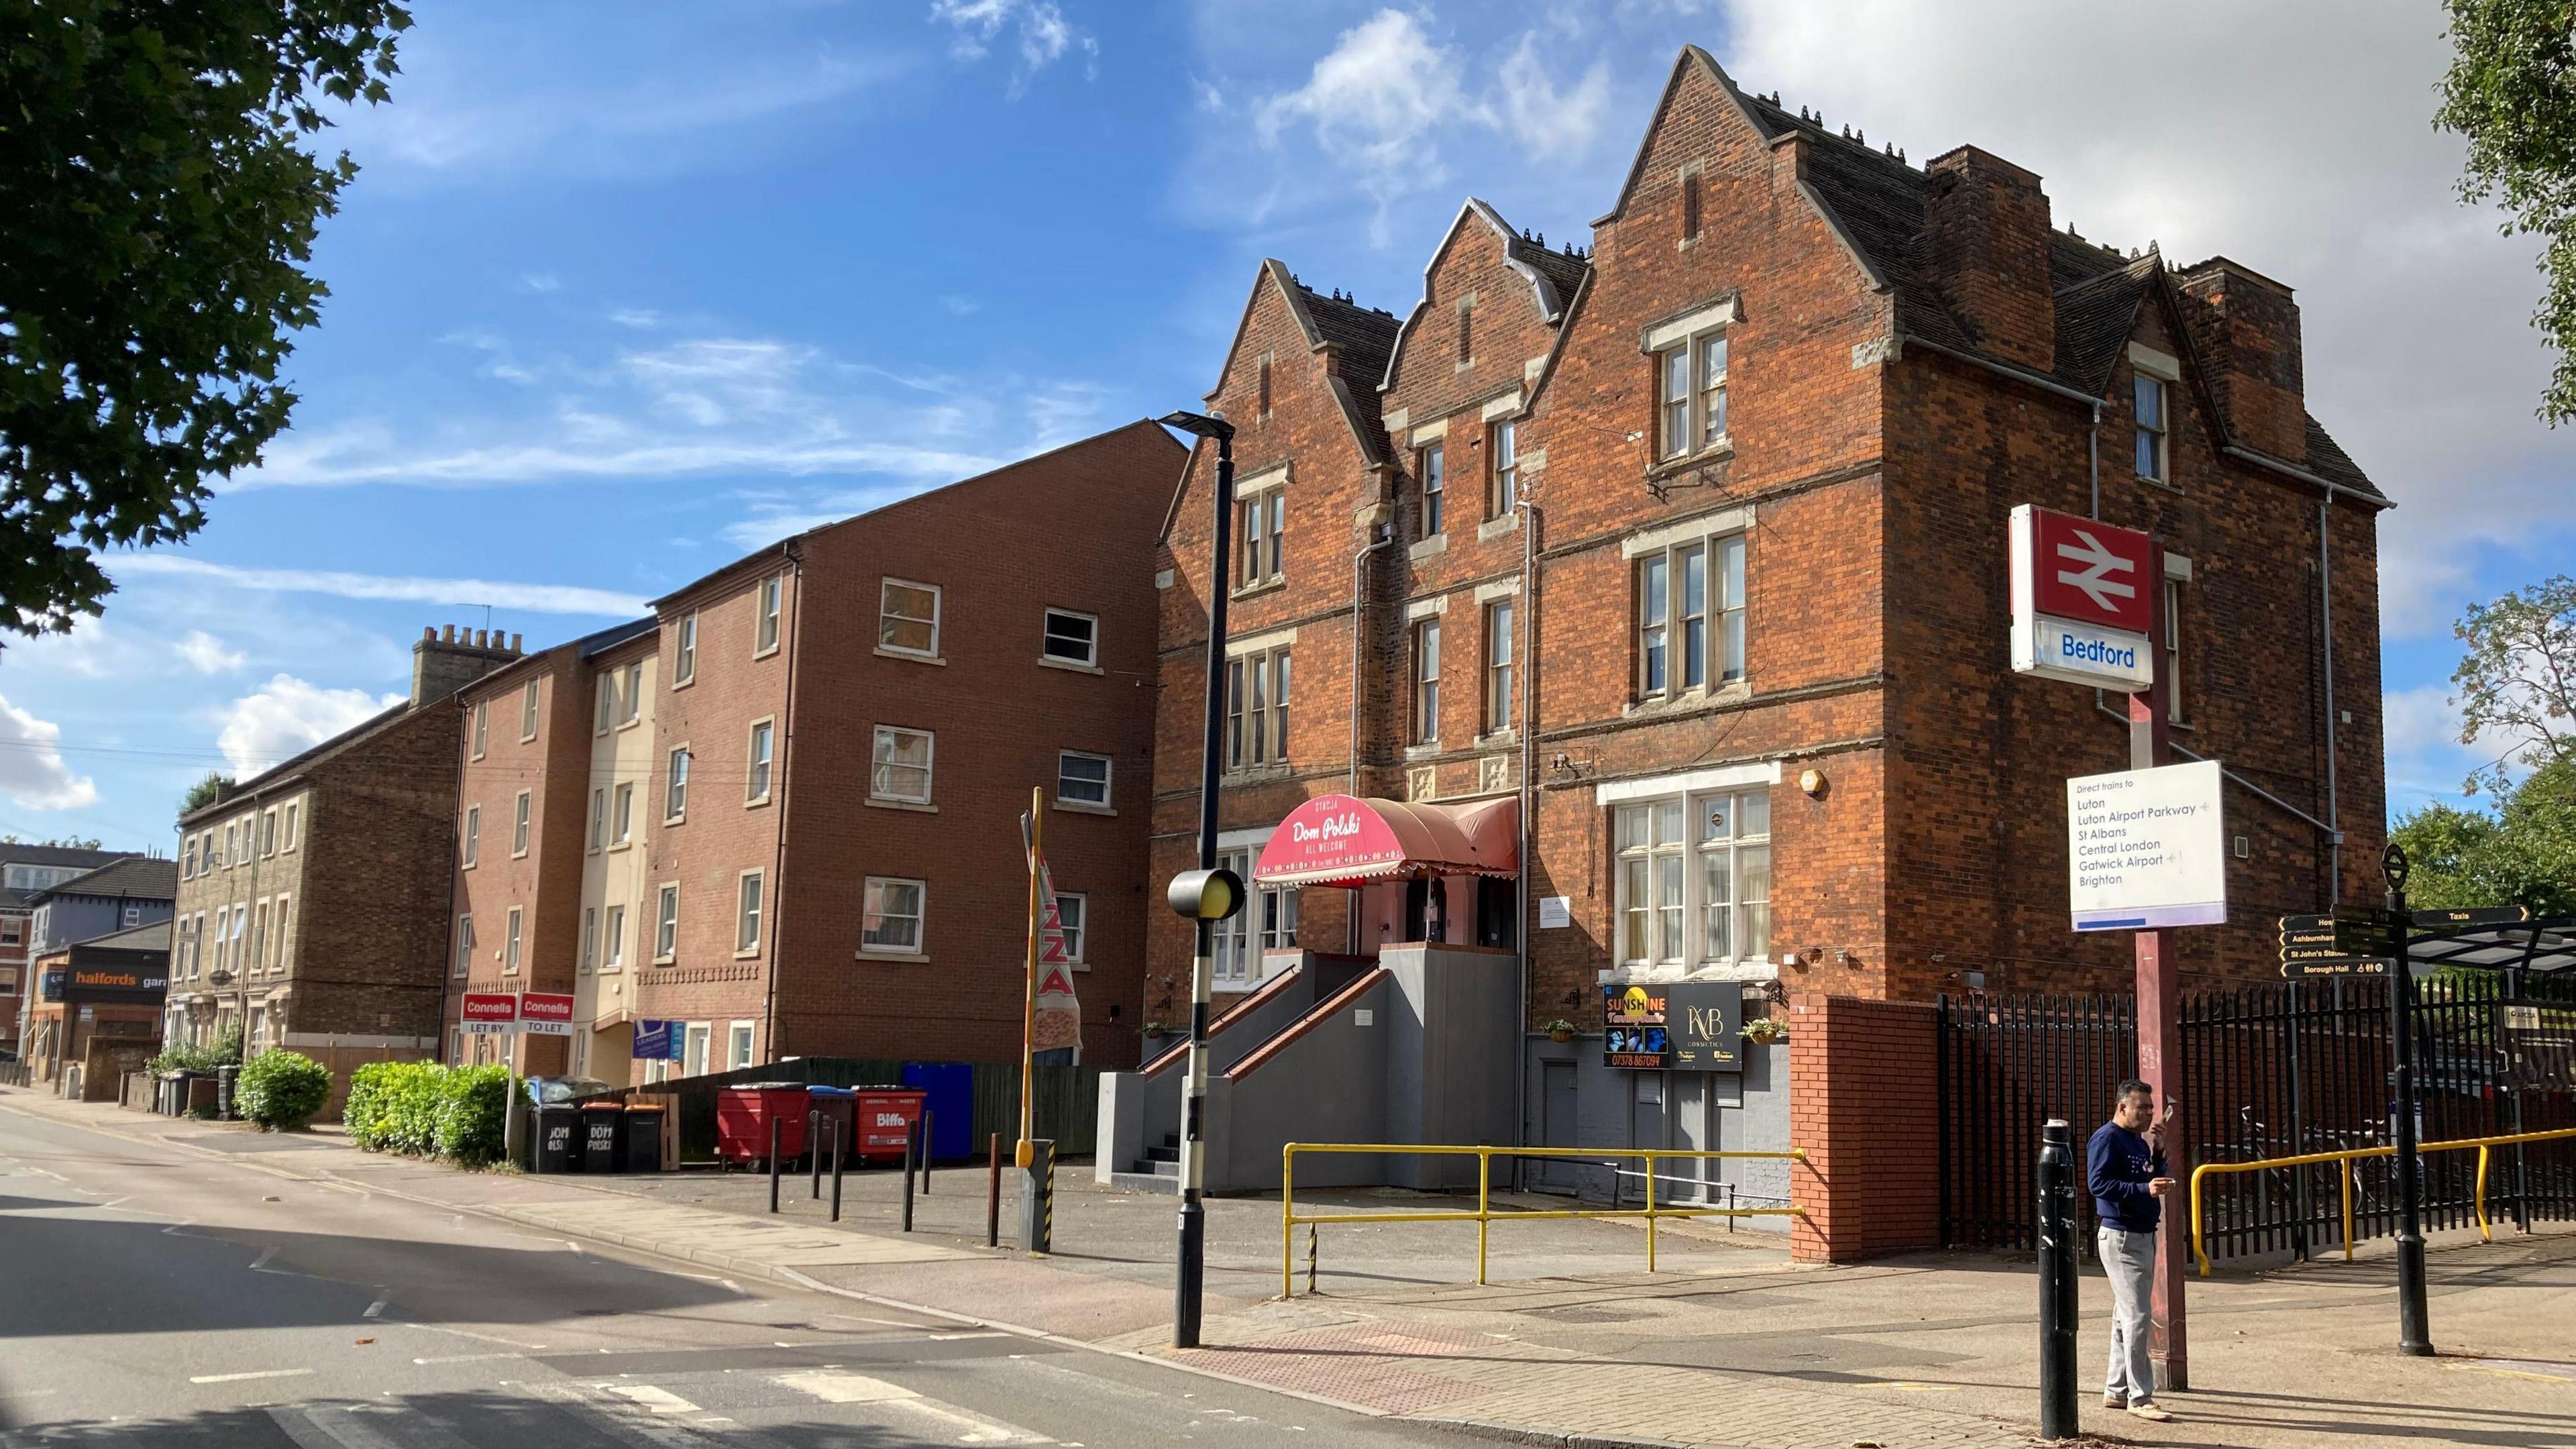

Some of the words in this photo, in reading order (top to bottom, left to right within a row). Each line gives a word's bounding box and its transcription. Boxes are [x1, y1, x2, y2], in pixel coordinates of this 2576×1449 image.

[2063, 634, 2135, 668] Bedford
[2077, 783, 2100, 794] Direct
[2102, 782, 2123, 791] trains
[1315, 800, 1338, 812] STACJA
[2078, 799, 2105, 810] Luton
[2078, 814, 2105, 825] Luton
[2109, 809, 2145, 823] Airport
[2148, 805, 2196, 818] Parkway
[1293, 821, 1320, 843] Dom
[1322, 812, 1360, 840] Polski
[2078, 830, 2087, 841] St
[2090, 828, 2127, 840] Albans
[1305, 843, 1316, 854] ALL
[1318, 840, 1347, 853] WELCOME
[2079, 843, 2116, 856] Central
[2121, 840, 2161, 853] London
[2080, 858, 2123, 871] Gatwick
[2126, 855, 2163, 868] Airport
[2080, 873, 2122, 888] Brighton
[2304, 966, 2334, 974] Borough
[76, 971, 136, 985] halfords
[468, 1002, 511, 1013] Connells
[525, 1001, 569, 1014] Connells
[1607, 998, 1666, 1011] SUNSHINE
[471, 1024, 488, 1032] LET
[491, 1024, 504, 1033] BY
[528, 1022, 542, 1031] TO
[545, 1023, 563, 1032] LET
[1612, 1055, 1633, 1066] 07378
[1634, 1056, 1660, 1067] 867094
[877, 1113, 905, 1127] Biffa
[590, 1126, 612, 1138] DOM
[587, 1140, 611, 1150] POLSKI
